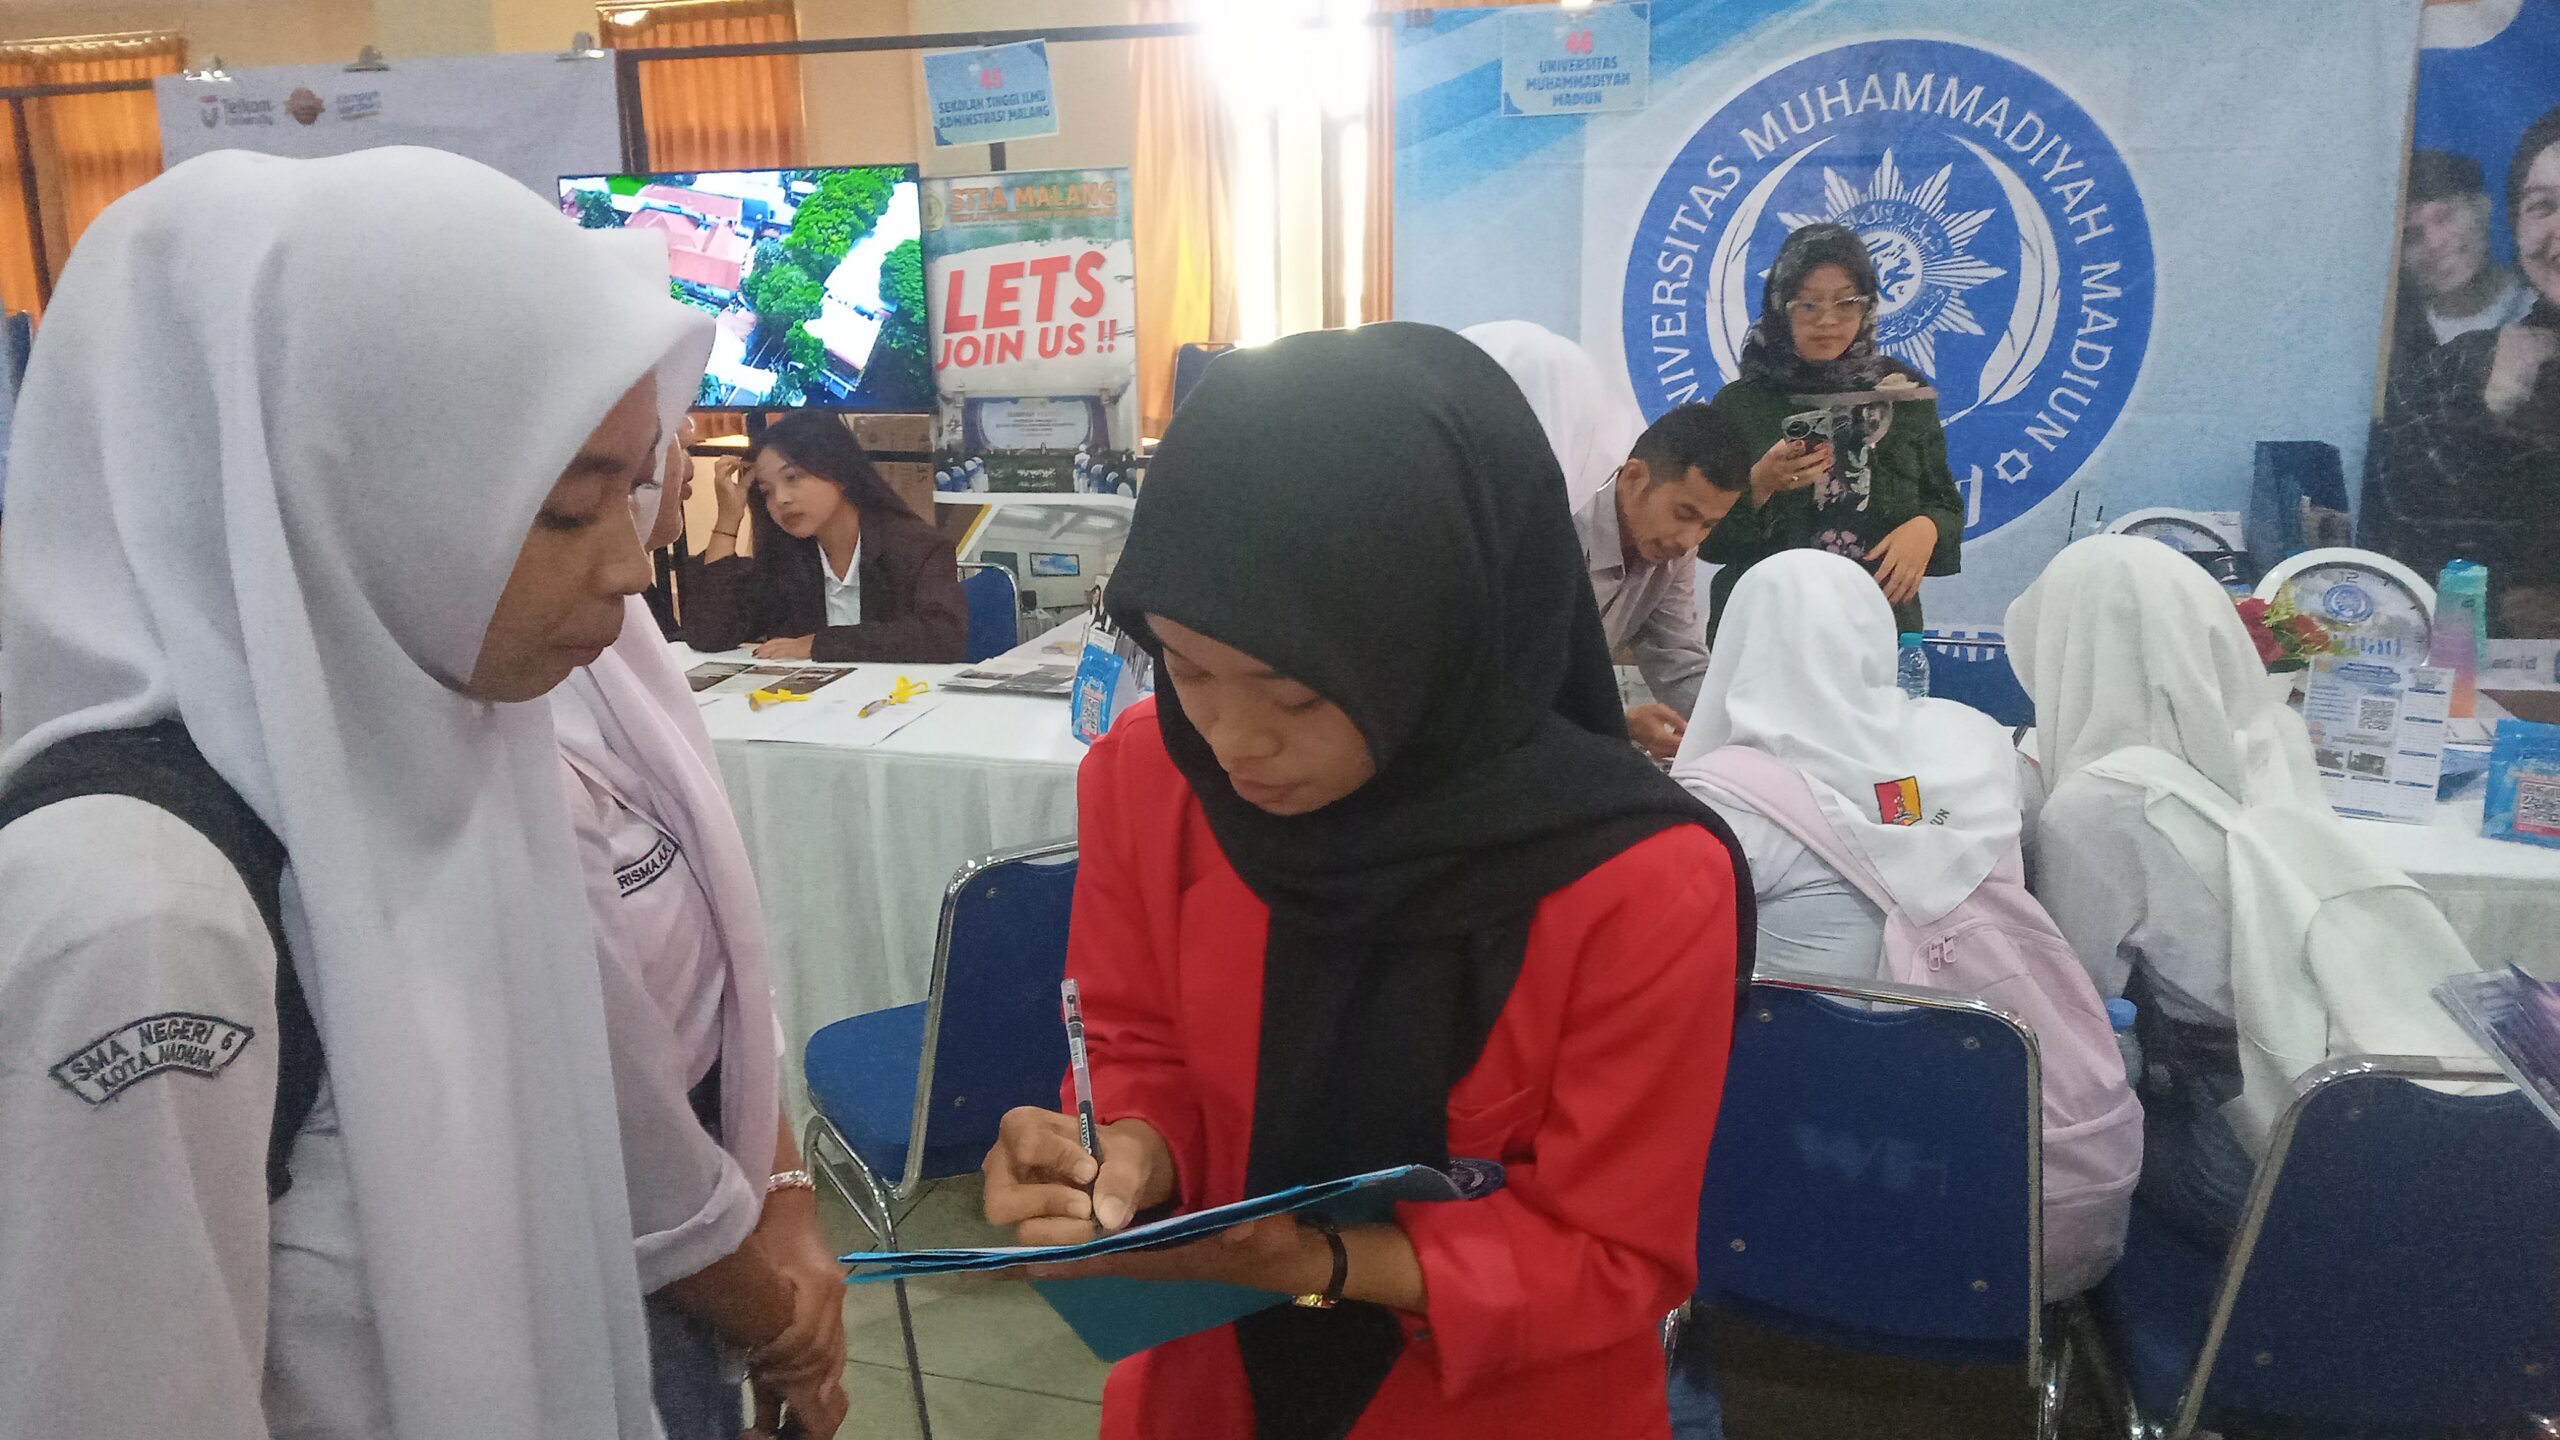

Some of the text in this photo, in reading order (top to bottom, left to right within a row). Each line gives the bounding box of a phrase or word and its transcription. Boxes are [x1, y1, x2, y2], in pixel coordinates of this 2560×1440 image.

[1525, 72, 1631, 91] MUHAMMADIYAH
[1539, 56, 1617, 73] UNIVERSITAS
[1552, 91, 1603, 106] MADIUN
[951, 181, 1117, 212] STIA MALANG
[1651, 71, 2123, 452] NIVERSITAS MUHAMMADIYAH MADIUN
[943, 250, 1106, 335] LETS
[934, 330, 1025, 372] JOIN
[1037, 322, 1086, 360] US
[616, 858, 660, 889] RISMA
[69, 1018, 237, 1082] SMA NEGERI 6
[96, 1050, 154, 1091] KOTA
